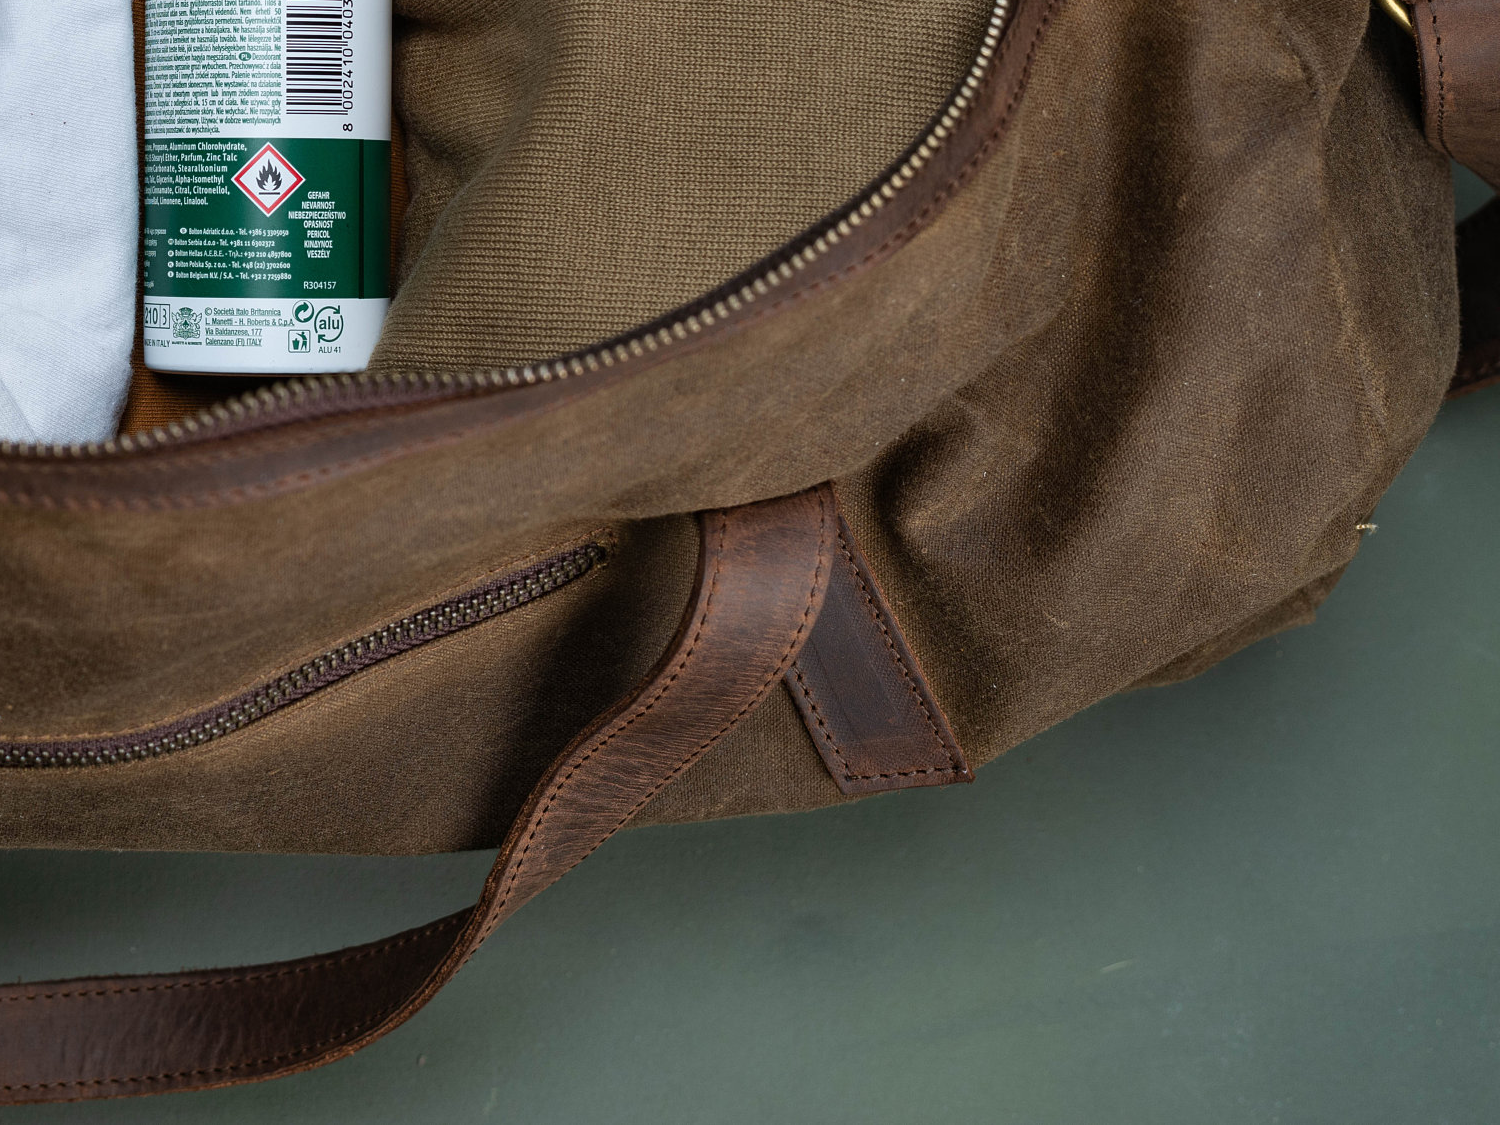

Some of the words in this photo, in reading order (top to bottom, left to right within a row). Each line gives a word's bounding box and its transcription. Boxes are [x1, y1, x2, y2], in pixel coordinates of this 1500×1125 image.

[342, 47, 354, 111] 002410
[342, 123, 354, 132] 8
[170, 141, 197, 151] Aluminum
[197, 141, 247, 152] Chlorohydrate,
[181, 152, 205, 163] Parfum,
[206, 152, 221, 161] Zinc
[222, 152, 238, 162] Talc
[177, 164, 228, 173] Stearalkonium
[175, 174, 225, 185] Alpha-Isomethyl
[174, 185, 192, 195] Citral,
[193, 185, 230, 195] Citronellol,
[307, 191, 331, 200] GEFAHR
[184, 196, 209, 206] Linalool.
[301, 201, 336, 210] NEVARNOST
[288, 210, 347, 220] NIEBEZPIECZEŃSTWO
[303, 220, 334, 229] OPASNOST
[307, 230, 331, 239] PERICOL
[306, 248, 331, 259] VESZÉLY
[303, 280, 337, 290] R304157
[213, 306, 235, 316] Società
[236, 307, 249, 316] Italo
[250, 307, 281, 317] Britannica
[212, 317, 233, 326] Manetti
[239, 317, 246, 326] H.
[247, 317, 271, 327] Roberts
[273, 318, 279, 327] &
[319, 316, 340, 331] alu
[205, 327, 214, 336] Via
[252, 328, 263, 336] 177
[205, 337, 234, 346] Calenzano
[247, 338, 262, 347] ITALY
[318, 346, 333, 354] ALU
[333, 346, 341, 354] 41
